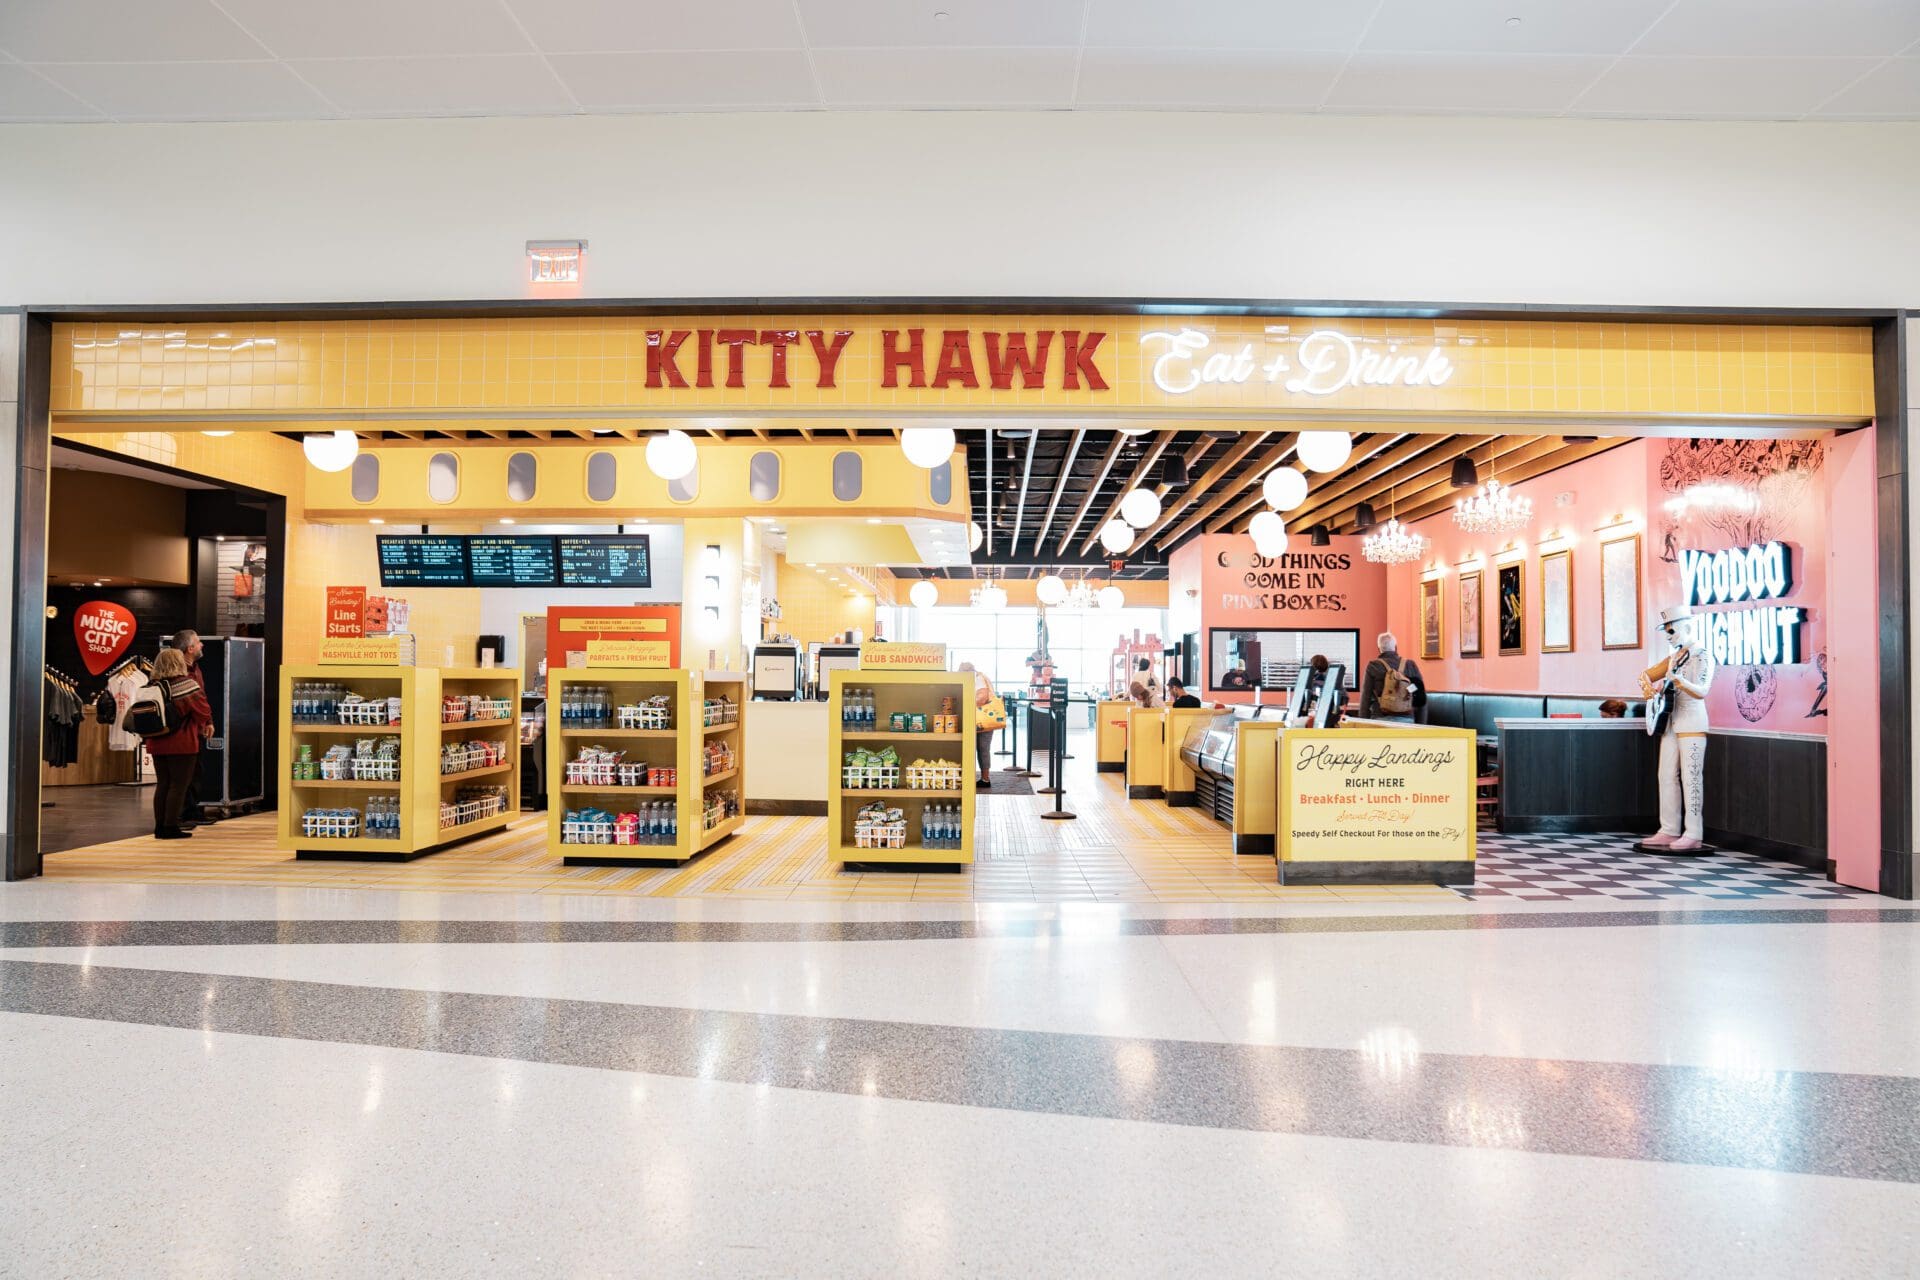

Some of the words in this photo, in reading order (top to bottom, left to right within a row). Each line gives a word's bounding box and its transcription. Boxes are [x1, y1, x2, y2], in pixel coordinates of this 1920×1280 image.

[644, 329, 854, 388] KITTY
[881, 329, 1110, 390] HAWK
[1140, 328, 1255, 393] Eat
[1285, 330, 1455, 394] Drink
[1218, 551, 1274, 568] GOD
[1280, 553, 1351, 570] THINGS
[1244, 572, 1301, 589] COME
[1306, 572, 1325, 589] IN
[1679, 541, 1790, 605] VOODOO
[1222, 593, 1269, 609] PINK
[98, 609, 116, 619] THE
[334, 609, 356, 620] Line
[80, 614, 129, 635] MUSIC
[328, 622, 361, 633] Starts
[84, 630, 121, 648] CITY
[88, 644, 112, 654] SHOP
[864, 654, 886, 663] CLUB
[890, 654, 944, 664] SANDWICH?
[1297, 744, 1368, 773] Happy
[1368, 744, 1455, 772] Landings
[1345, 778, 1375, 788] RIGHT
[1378, 778, 1406, 788] HERE
[1300, 793, 1356, 804] Breakfast
[1367, 793, 1402, 804] Lunch
[1412, 792, 1450, 804] Dinner
[1292, 830, 1320, 839] Speedy
[1322, 830, 1338, 838] Self
[1340, 830, 1375, 838] Checkout
[1378, 830, 1390, 838] For
[1392, 830, 1414, 838] those
[1416, 830, 1426, 838] on
[1427, 830, 1440, 838] the
